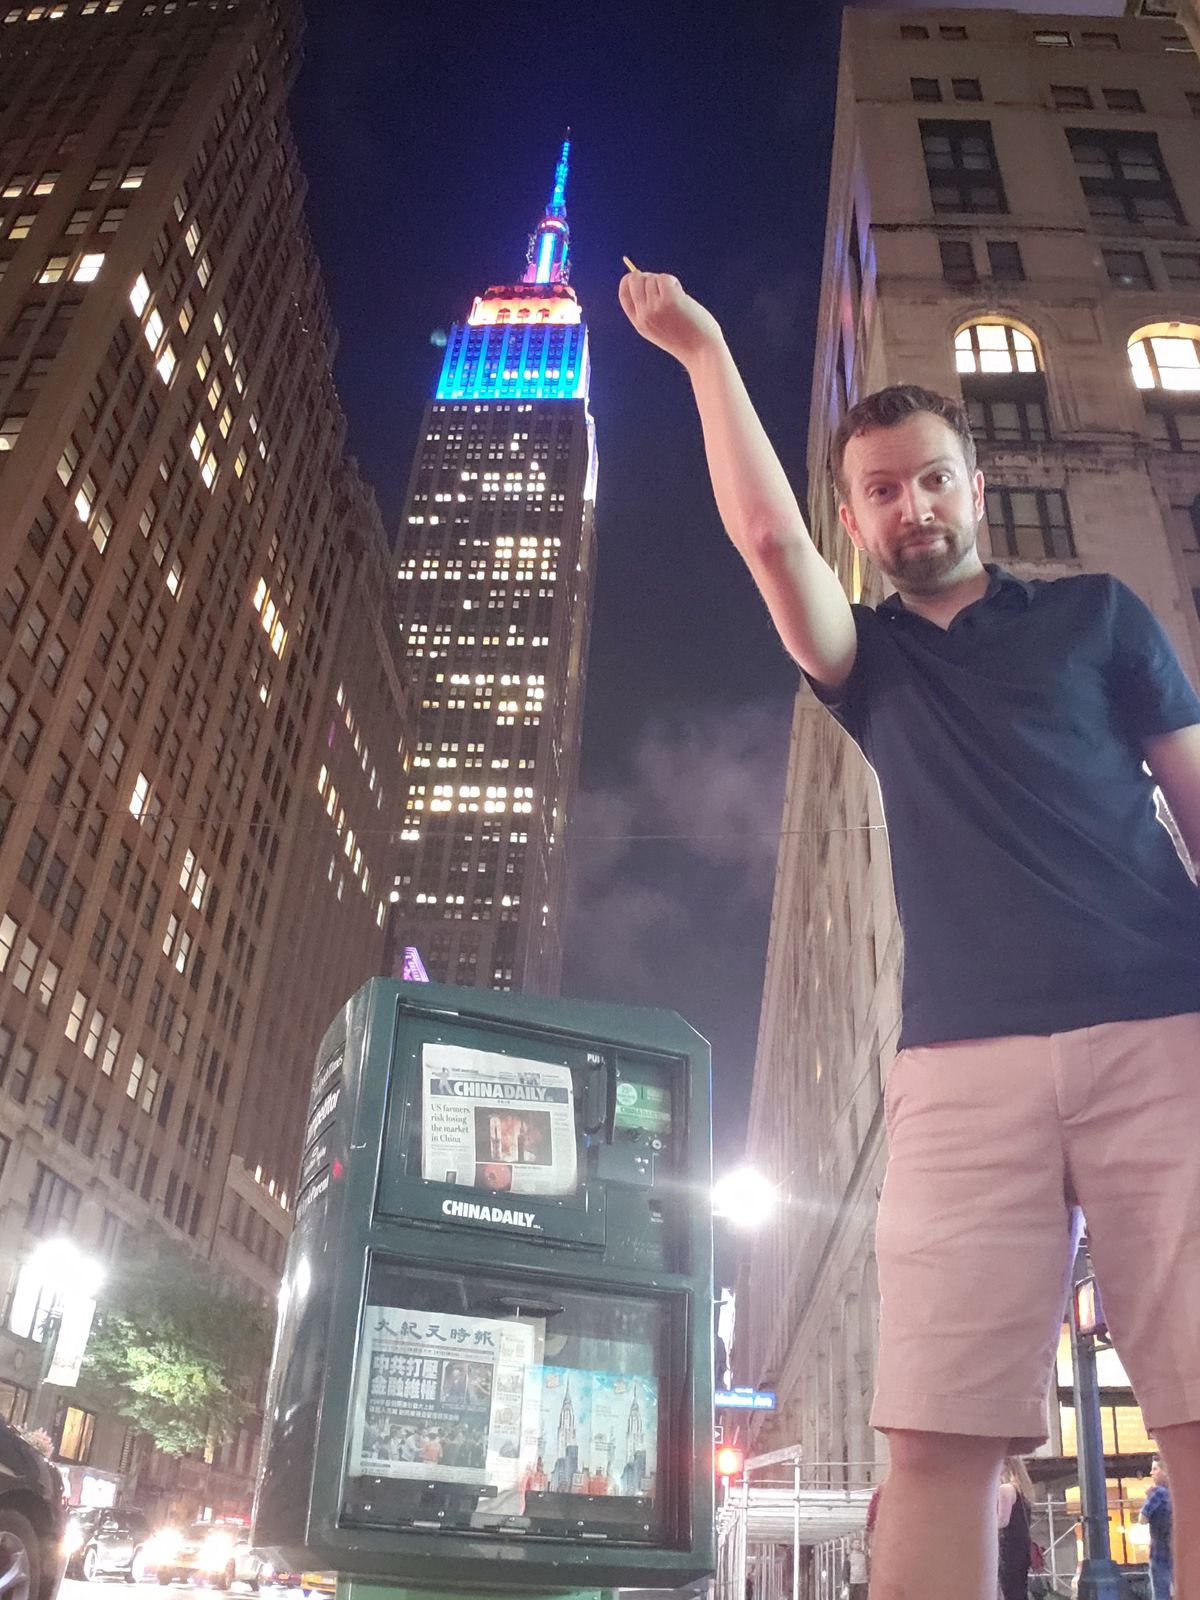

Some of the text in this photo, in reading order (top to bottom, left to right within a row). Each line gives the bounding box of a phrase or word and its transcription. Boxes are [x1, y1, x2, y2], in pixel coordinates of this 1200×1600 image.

[431, 1103, 470, 1114] US farmers
[431, 1114, 467, 1124] risk losing
[431, 1124, 469, 1134] the market
[431, 1134, 461, 1143] in China
[373, 1316, 496, 1347] 大紀元時報
